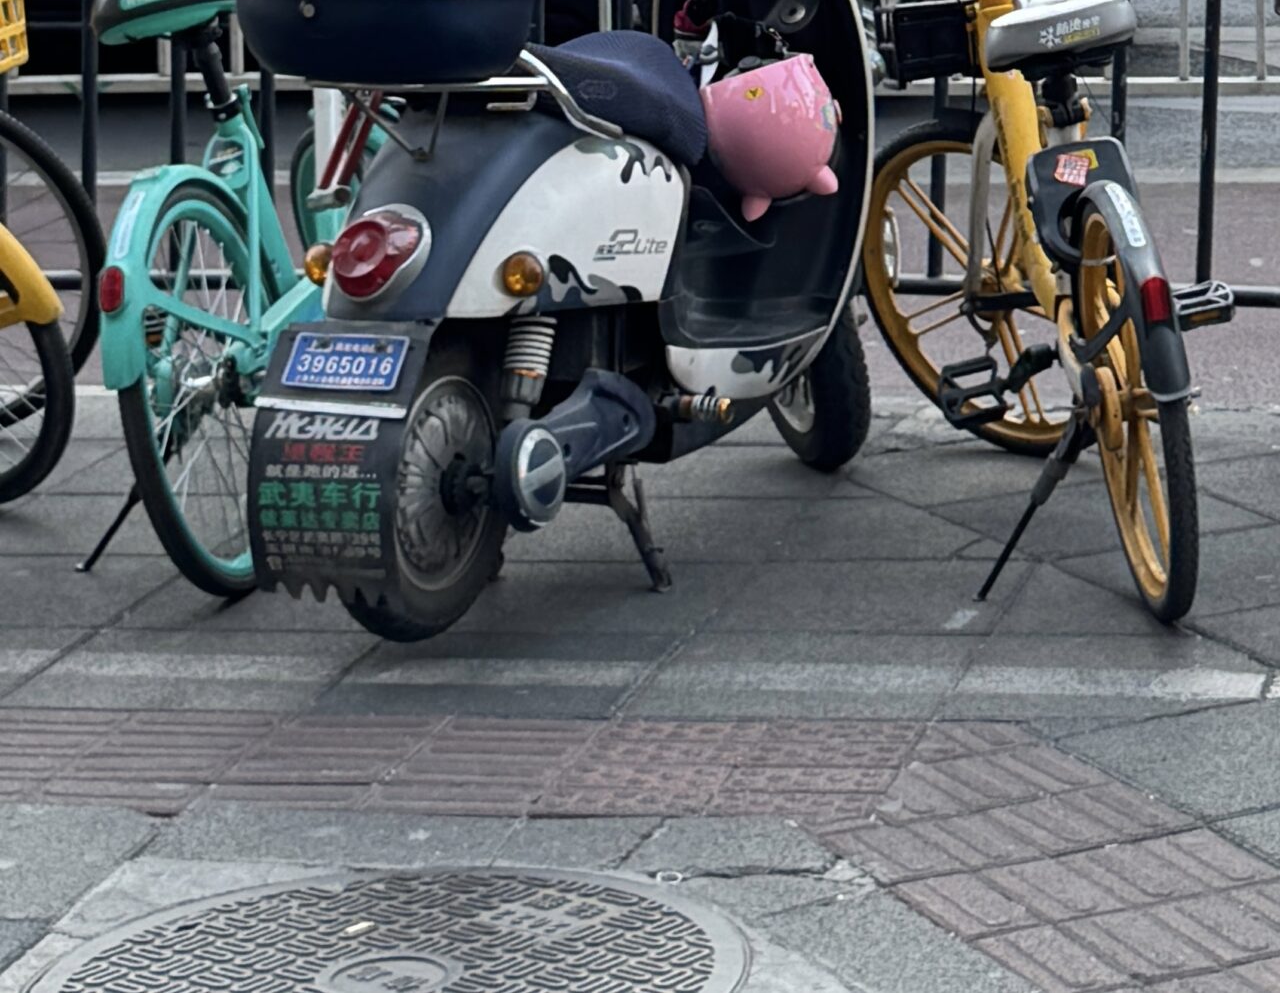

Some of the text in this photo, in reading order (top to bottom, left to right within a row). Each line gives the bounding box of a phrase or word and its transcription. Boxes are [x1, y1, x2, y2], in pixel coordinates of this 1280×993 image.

[296, 353, 394, 376] 3965016
[258, 481, 381, 509] 武夷车行
